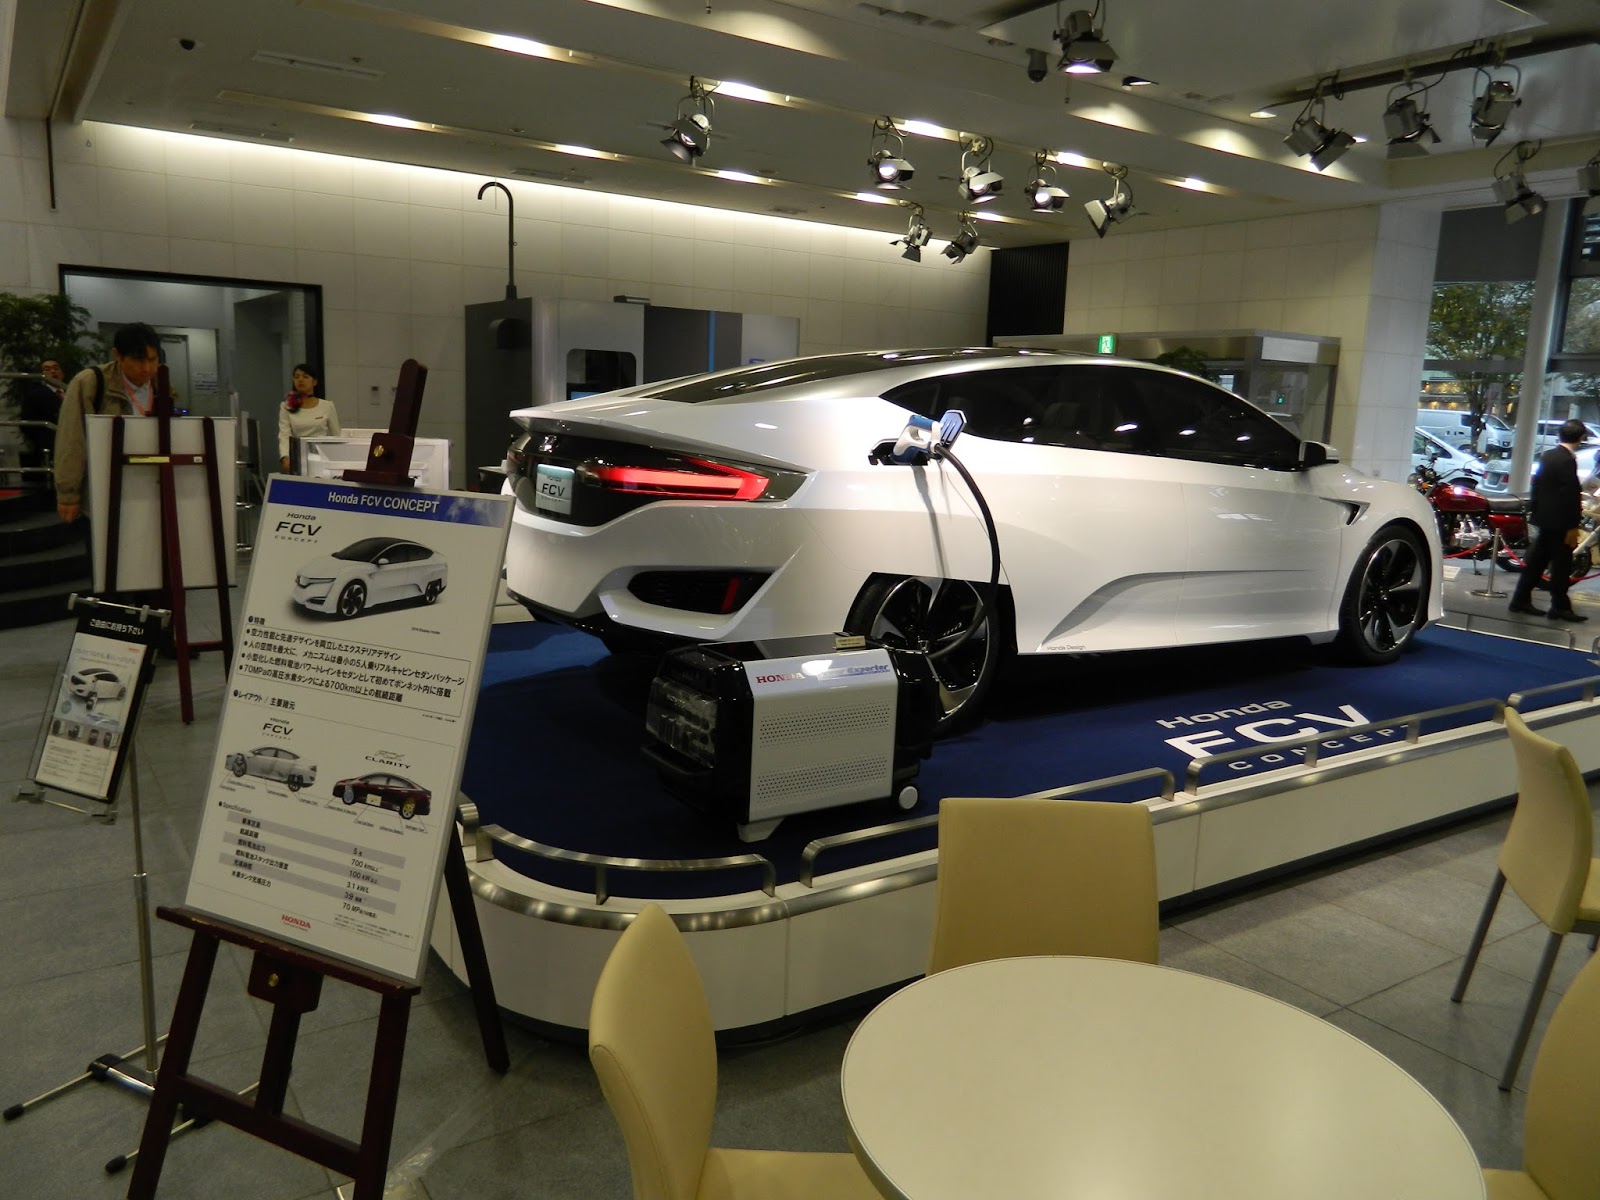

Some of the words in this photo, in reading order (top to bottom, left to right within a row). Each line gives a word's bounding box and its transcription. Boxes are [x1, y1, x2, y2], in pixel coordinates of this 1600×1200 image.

[542, 483, 565, 497] FCV
[327, 491, 359, 505] Honda
[360, 494, 382, 507] FCV
[383, 496, 440, 514] CONCEPT
[286, 512, 317, 521] Honda
[275, 521, 322, 537] FCV
[274, 535, 319, 544] CONCEPT
[756, 672, 806, 684] HONDA
[847, 664, 888, 674] Exporter
[238, 691, 263, 702] レイアウト
[1156, 700, 1292, 729] Honda
[263, 723, 294, 736] FCV
[1164, 704, 1371, 759] FCV
[1228, 725, 1408, 771] CONCEP
[365, 756, 411, 769] CLARITY
[223, 802, 252, 814] Specification
[351, 858, 364, 868] 700
[349, 870, 361, 879] 100
[342, 902, 351, 911] 70
[281, 914, 312, 929] HONDA
